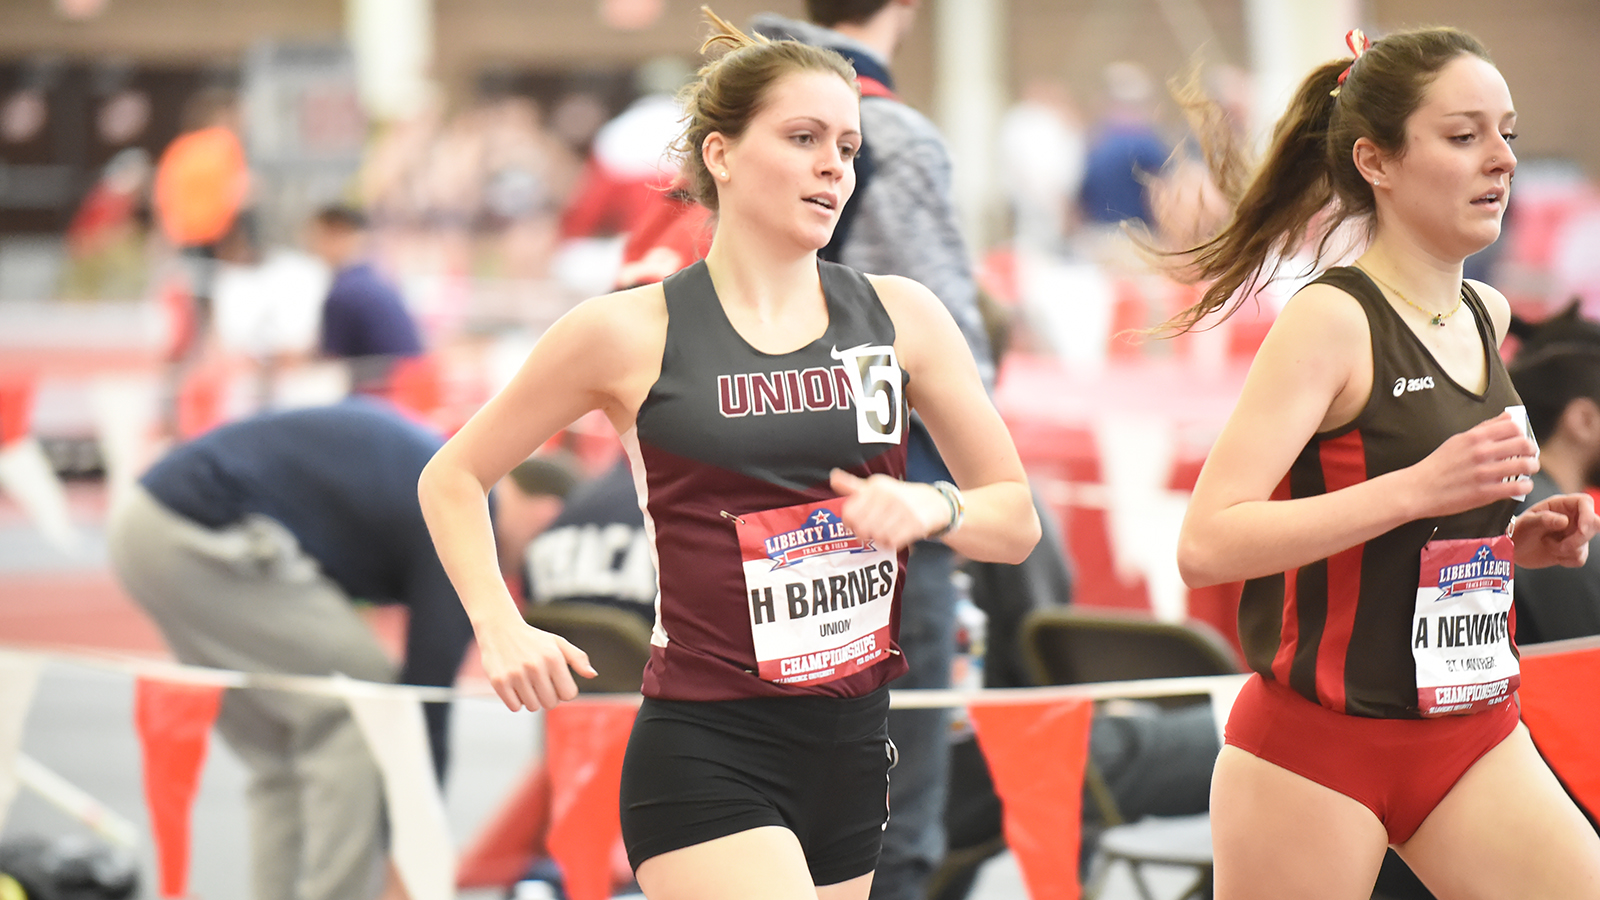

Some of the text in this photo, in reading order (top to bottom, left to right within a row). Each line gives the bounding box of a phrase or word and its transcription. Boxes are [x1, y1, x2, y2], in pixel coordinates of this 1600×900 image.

[717, 365, 857, 418] UNION
[856, 354, 897, 435] 5
[1406, 376, 1435, 392] asics
[765, 525, 824, 554] LIBERTY
[802, 546, 823, 556] TRACK
[831, 541, 849, 551] FIELD
[1439, 560, 1510, 583] LIBERTY LEAGUE
[751, 560, 894, 625] H BARNES
[819, 618, 852, 638] UNION
[1415, 617, 1428, 649] A
[780, 633, 876, 676] CHAMPIONSHIPS
[1435, 679, 1510, 705] CHAMPIONSHIPS
